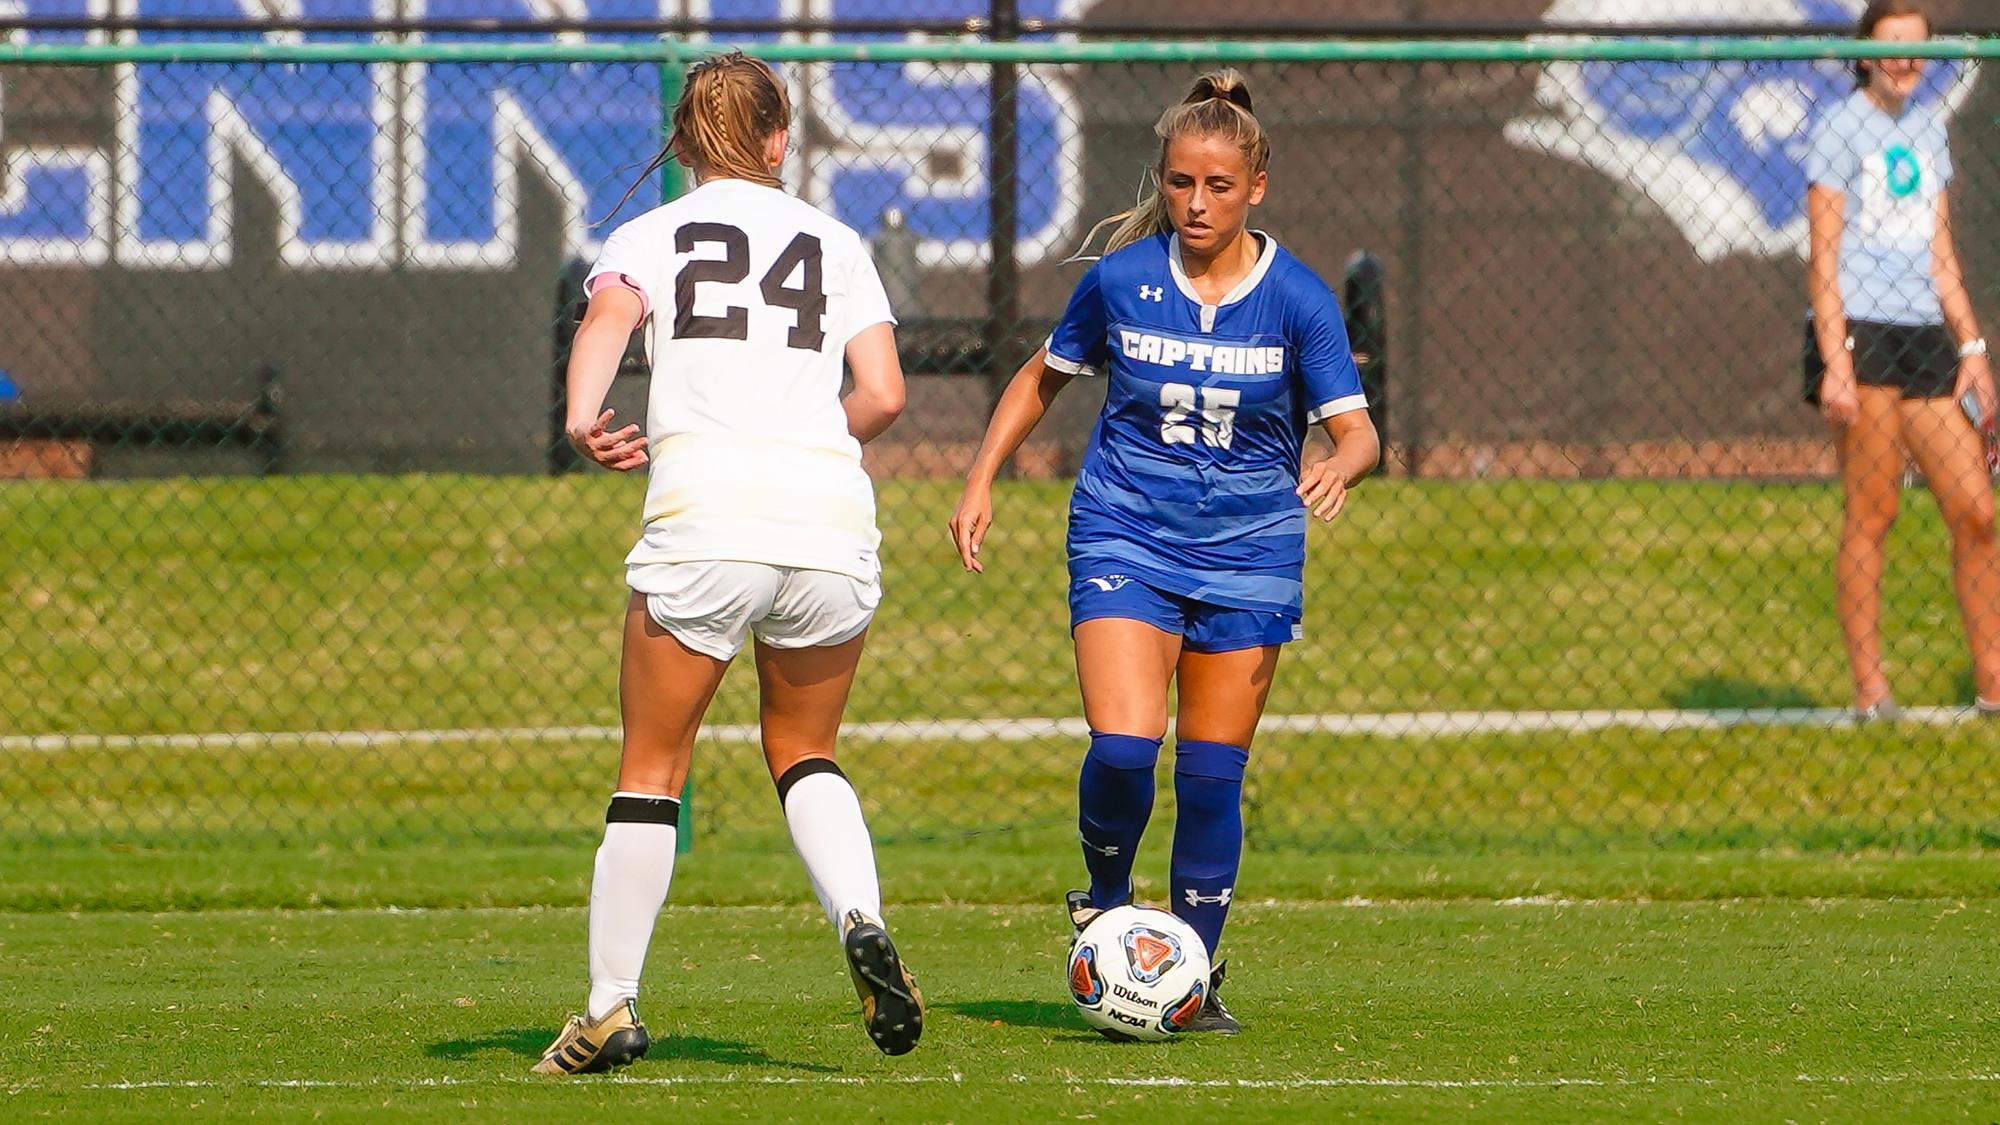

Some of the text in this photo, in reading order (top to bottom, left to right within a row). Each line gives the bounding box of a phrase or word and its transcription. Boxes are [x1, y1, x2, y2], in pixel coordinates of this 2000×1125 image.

[672, 222, 827, 353] 24
[1119, 330, 1284, 376] CAPTAINS
[1160, 382, 1241, 450] 25
[1109, 1009, 1148, 1028] NCAA
[1113, 984, 1157, 1008] Wilson
